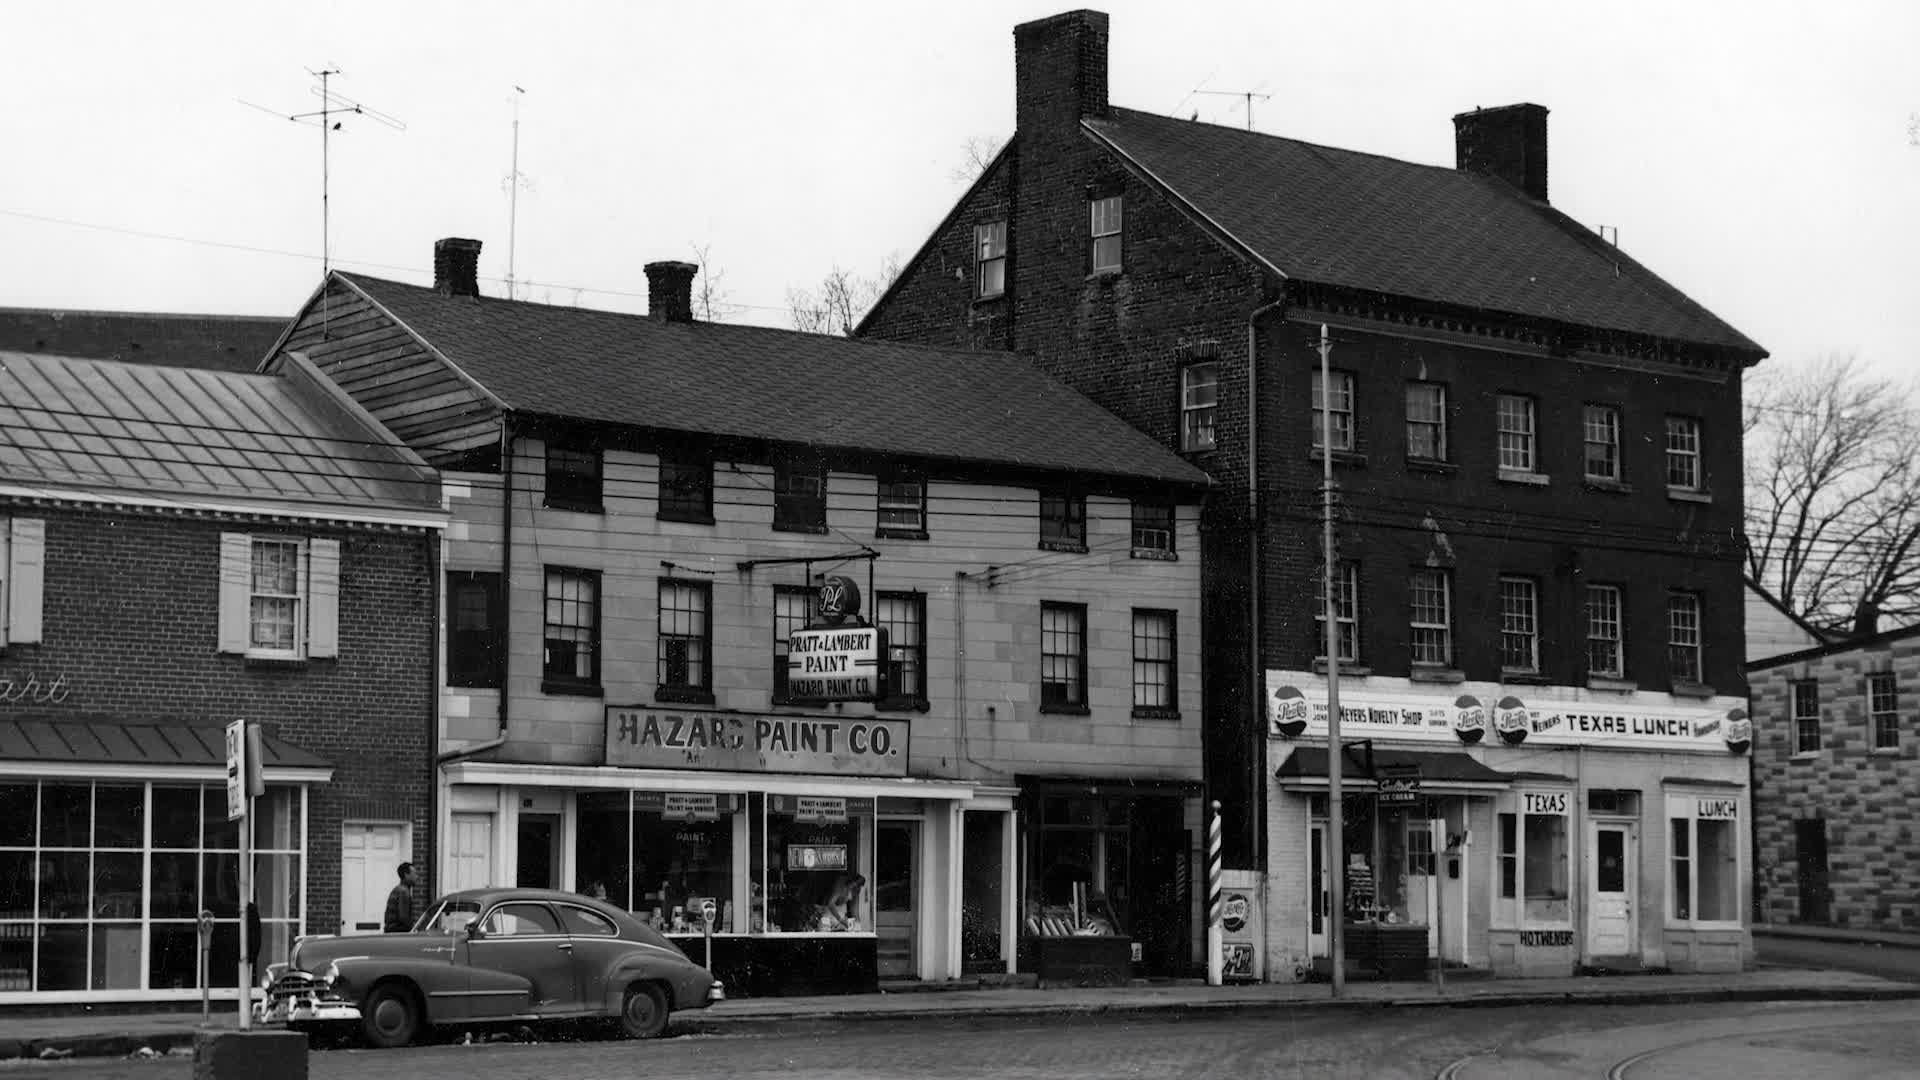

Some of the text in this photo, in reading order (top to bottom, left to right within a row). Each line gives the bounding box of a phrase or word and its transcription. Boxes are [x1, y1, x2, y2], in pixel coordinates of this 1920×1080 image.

[790, 635, 819, 652] PRATT
[824, 634, 871, 651] LAMBERT
[806, 656, 848, 672] PAINT
[789, 680, 823, 697] HAZARD
[827, 679, 852, 696] PAINT
[1368, 707, 1398, 724] NOVELTY
[1401, 709, 1422, 725] SHOP
[1566, 714, 1626, 732] TEXAS
[1633, 718, 1689, 736] LUNCH
[619, 714, 897, 756] HAZARD PAINT CO.
[1524, 794, 1737, 818] TEXAS LUNCH
